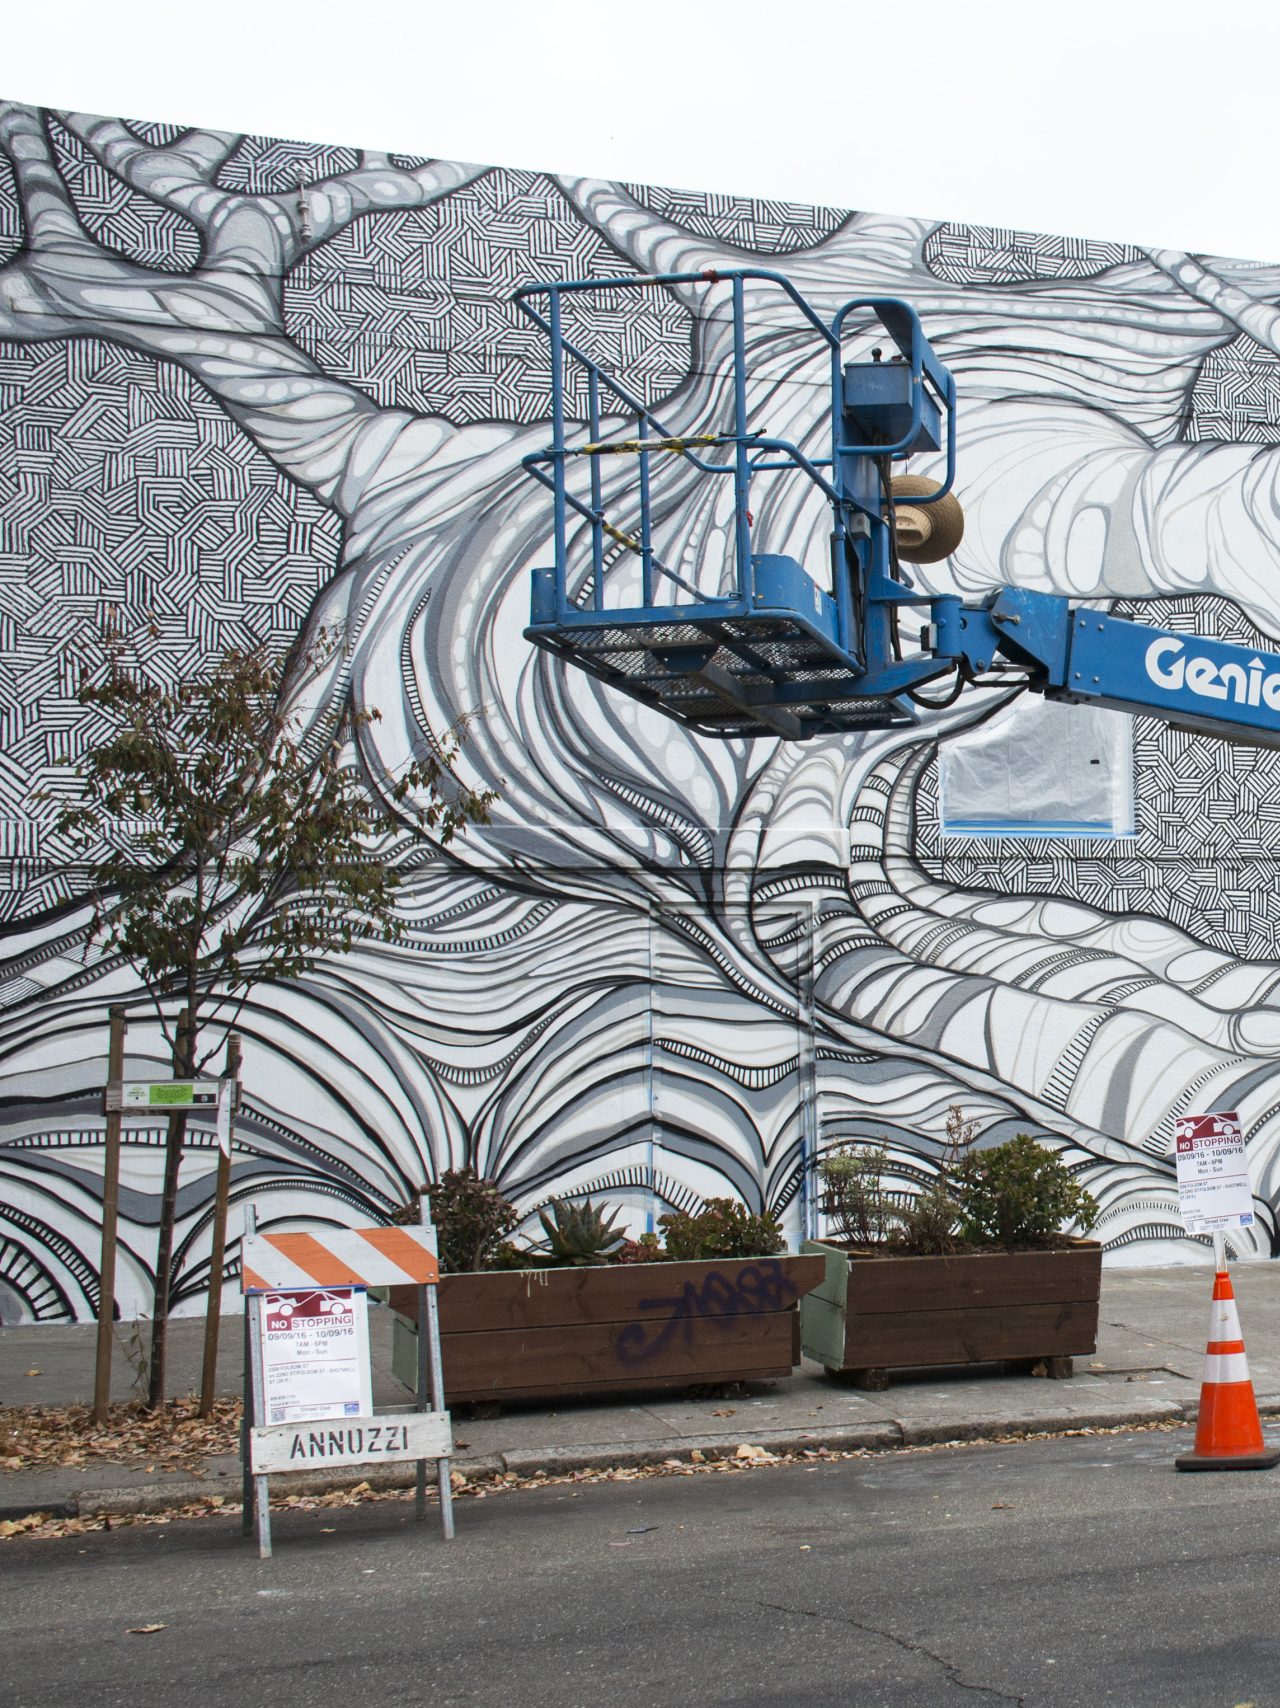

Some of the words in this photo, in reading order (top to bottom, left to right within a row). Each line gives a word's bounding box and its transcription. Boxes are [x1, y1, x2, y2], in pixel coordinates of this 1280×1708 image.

[1193, 1135, 1240, 1148] STOPPING
[1178, 1152, 1205, 1161] 09/09/16
[1212, 1147, 1243, 1156] 10/09/16
[271, 1320, 288, 1329] NO
[292, 1315, 352, 1328] STOPPING
[267, 1331, 307, 1341] 09/09/16
[315, 1328, 354, 1338] 10/09/16
[290, 1425, 409, 1460] ANNUZZI
